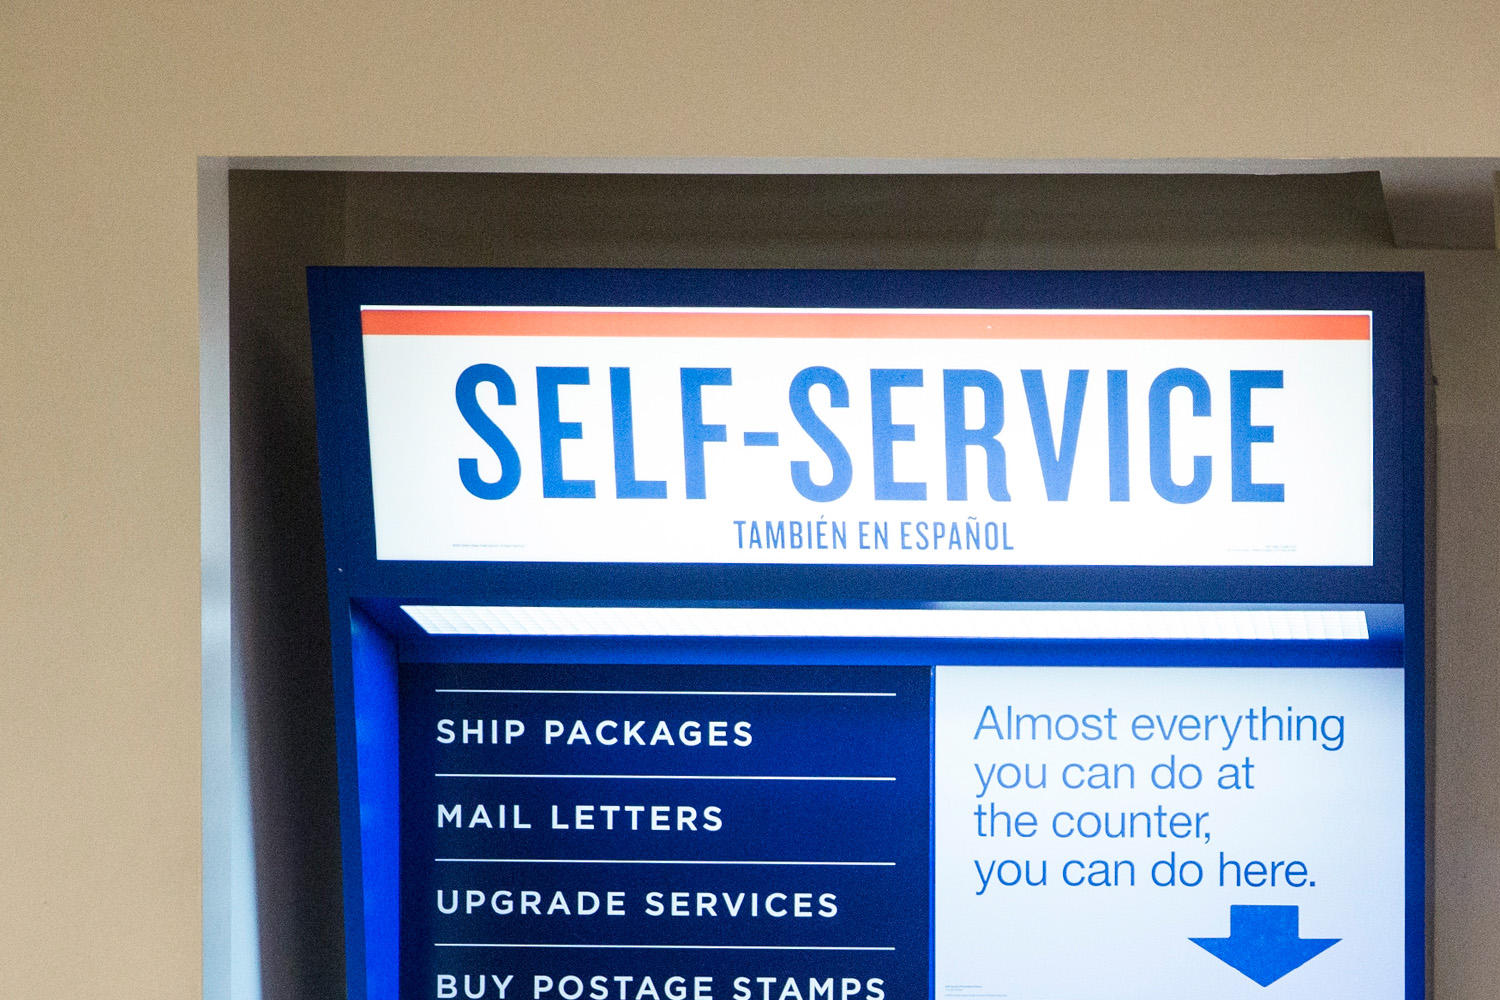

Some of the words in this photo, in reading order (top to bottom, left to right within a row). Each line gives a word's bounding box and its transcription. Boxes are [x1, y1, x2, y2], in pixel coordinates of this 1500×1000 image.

[455, 363, 1284, 503] SELF-SERVICE
[733, 515, 846, 549] TAMBIÉN
[859, 521, 888, 549] EN
[901, 516, 1014, 550] ESPAÑOL
[437, 719, 525, 744] SHIP
[546, 720, 752, 747] PACKAGES
[974, 705, 1117, 740] Almost
[1132, 706, 1344, 751] everything
[974, 763, 1046, 798] you
[1062, 763, 1134, 789] can
[1151, 755, 1202, 789] do
[1218, 757, 1254, 790] at
[438, 804, 531, 829] MAIL
[552, 805, 722, 831] LETTERS
[974, 802, 1037, 837] the
[1052, 805, 1210, 844] counter,
[974, 860, 1046, 895] you
[1062, 860, 1135, 887] can
[1151, 852, 1203, 887] do
[1220, 852, 1315, 887] here.
[437, 890, 625, 915] UPGRADE
[646, 892, 837, 917] SERVICES
[437, 974, 513, 999] BUY
[534, 975, 713, 1000] POSTAGE
